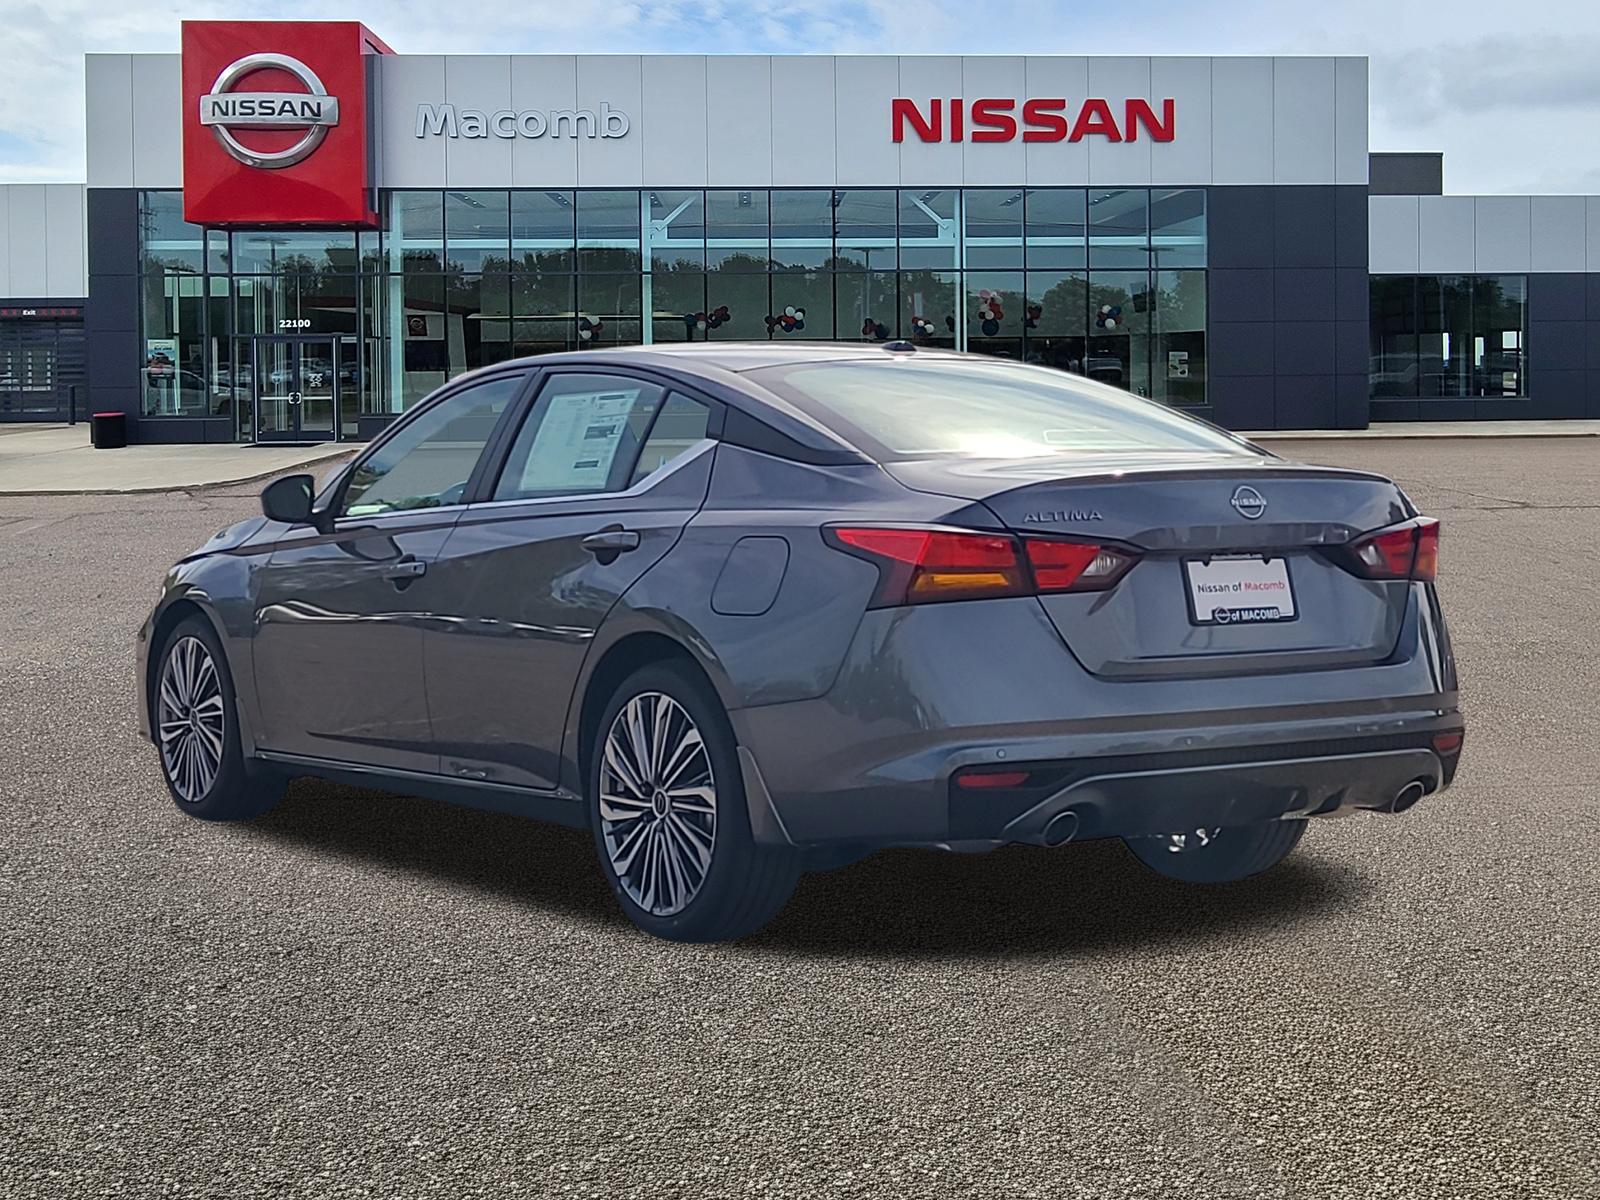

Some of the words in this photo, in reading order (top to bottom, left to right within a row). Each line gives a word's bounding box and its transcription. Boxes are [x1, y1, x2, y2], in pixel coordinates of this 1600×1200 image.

[211, 99, 322, 118] NISSAN
[415, 102, 630, 138] Macomb
[891, 98, 1176, 143] NISSAN
[22, 308, 37, 317] Exit
[279, 319, 311, 329] 22100
[1231, 498, 1267, 506] NISSAN
[1023, 510, 1105, 524] ALTIMA
[1197, 583, 1231, 593] Nissan
[1232, 581, 1242, 592] of
[1244, 580, 1286, 591] Macomb
[1231, 610, 1240, 621] of
[1241, 608, 1281, 620] MACOMB
